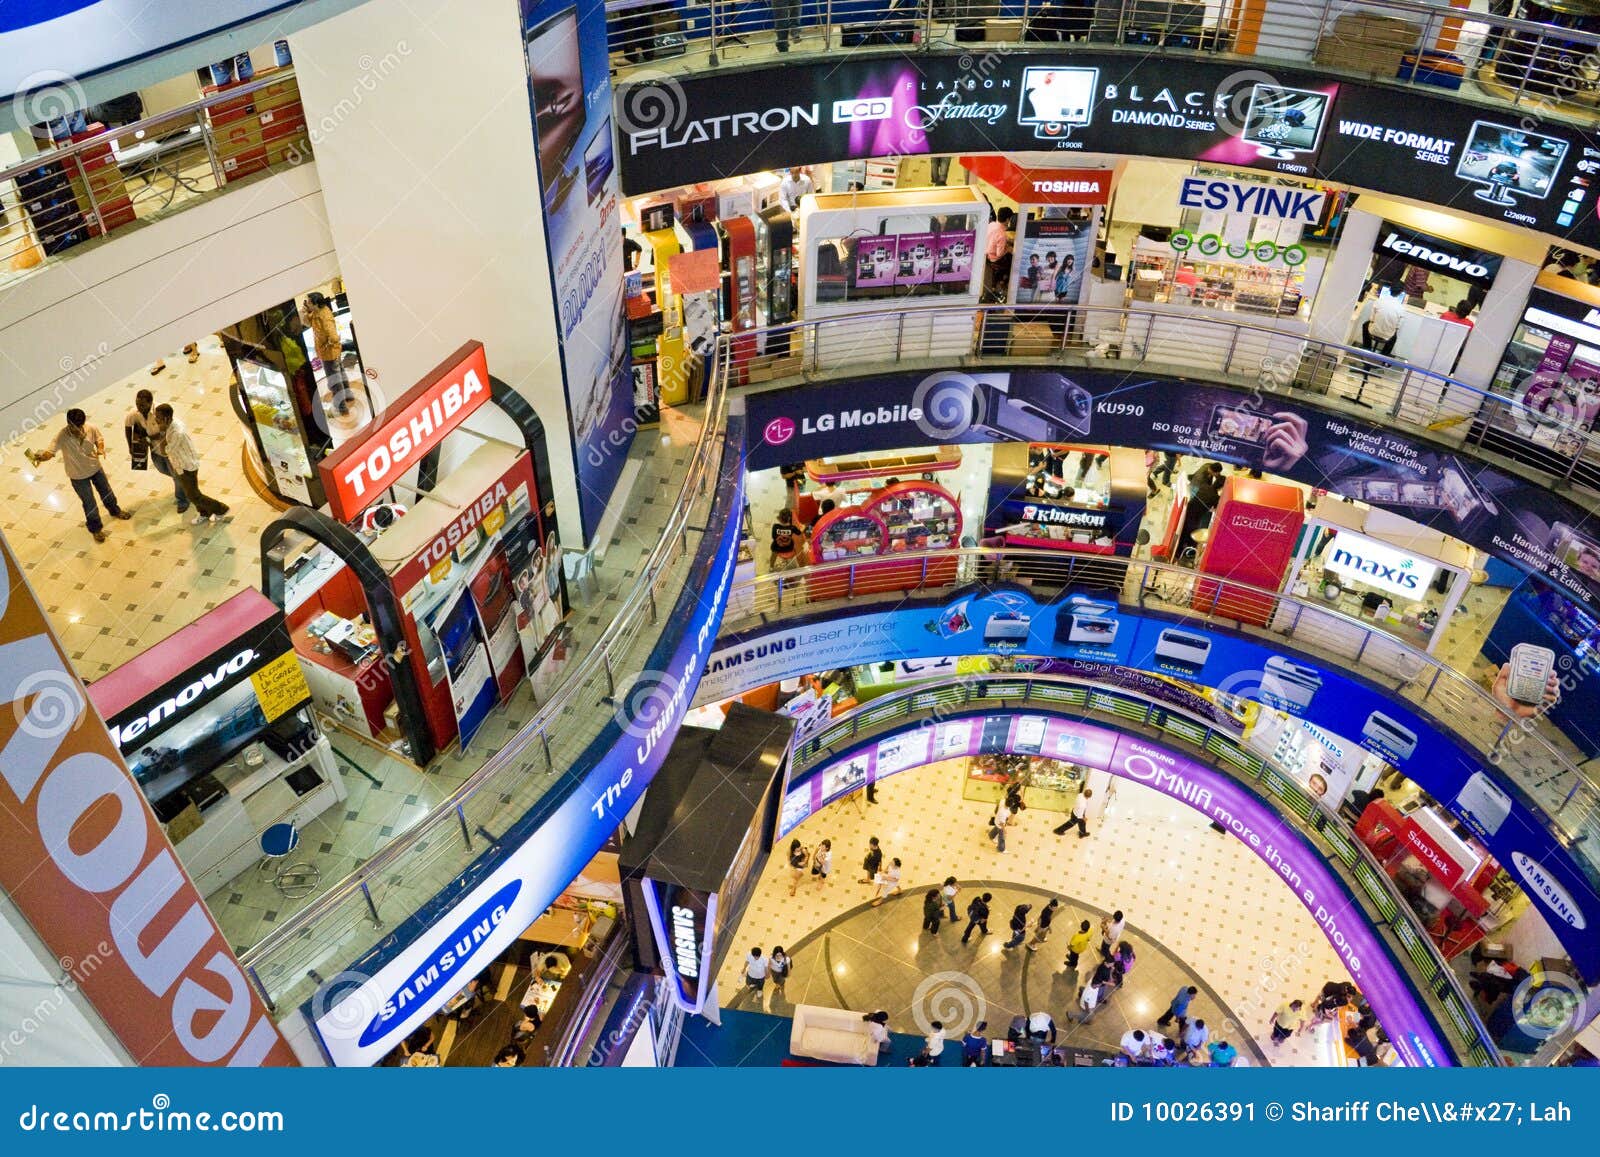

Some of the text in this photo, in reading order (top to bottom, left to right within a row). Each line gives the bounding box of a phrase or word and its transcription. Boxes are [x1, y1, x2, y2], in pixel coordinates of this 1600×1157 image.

[905, 79, 1011, 91] FLATRON
[1104, 84, 1232, 112] BLACK
[630, 99, 887, 156] FLATRON LCD
[1111, 108, 1216, 131] DIAMOND SERIES
[1340, 120, 1455, 155] WIDE FORMAT
[1057, 140, 1083, 149] L1900R
[1415, 151, 1450, 165] SERIES
[1032, 181, 1100, 193] TOSHIBA
[1277, 162, 1308, 174] L1960TR
[1179, 177, 1323, 222] ESYINK
[1382, 231, 1489, 278] lenovo
[802, 416, 835, 436] LG
[840, 405, 924, 429] Mobile
[1096, 400, 1144, 418] KU990
[345, 368, 483, 497] TOSHIBA
[1151, 421, 1202, 437] ISO 800 &
[1326, 420, 1419, 459] High-speed 120fps
[1348, 438, 1428, 475] Video Recording
[418, 480, 508, 570] TOSHIBA
[1037, 508, 1107, 527] Kingston
[1333, 548, 1419, 590] maxis
[1492, 534, 1593, 603] Recognition & Editing
[1512, 533, 1570, 574] Handwriting
[701, 637, 797, 677] SAMSUNG
[799, 628, 844, 647] Laser
[1073, 660, 1112, 674] Digital
[1114, 668, 1164, 688] Camera
[591, 767, 633, 820] The
[636, 659, 697, 765] Ultimate
[1130, 742, 1176, 766] SAMSUNG
[1302, 720, 1344, 758] PHILIPS
[1124, 754, 1213, 809] OMNIA
[1213, 805, 1262, 847] more
[1265, 844, 1303, 889] than
[1304, 888, 1316, 904] a
[1315, 904, 1363, 980] phone.
[1407, 830, 1450, 877] SanDisk
[1520, 856, 1576, 926] SAMSUNG
[671, 905, 698, 979] SAMSUNG
[380, 904, 509, 1022] SAMSUNG
